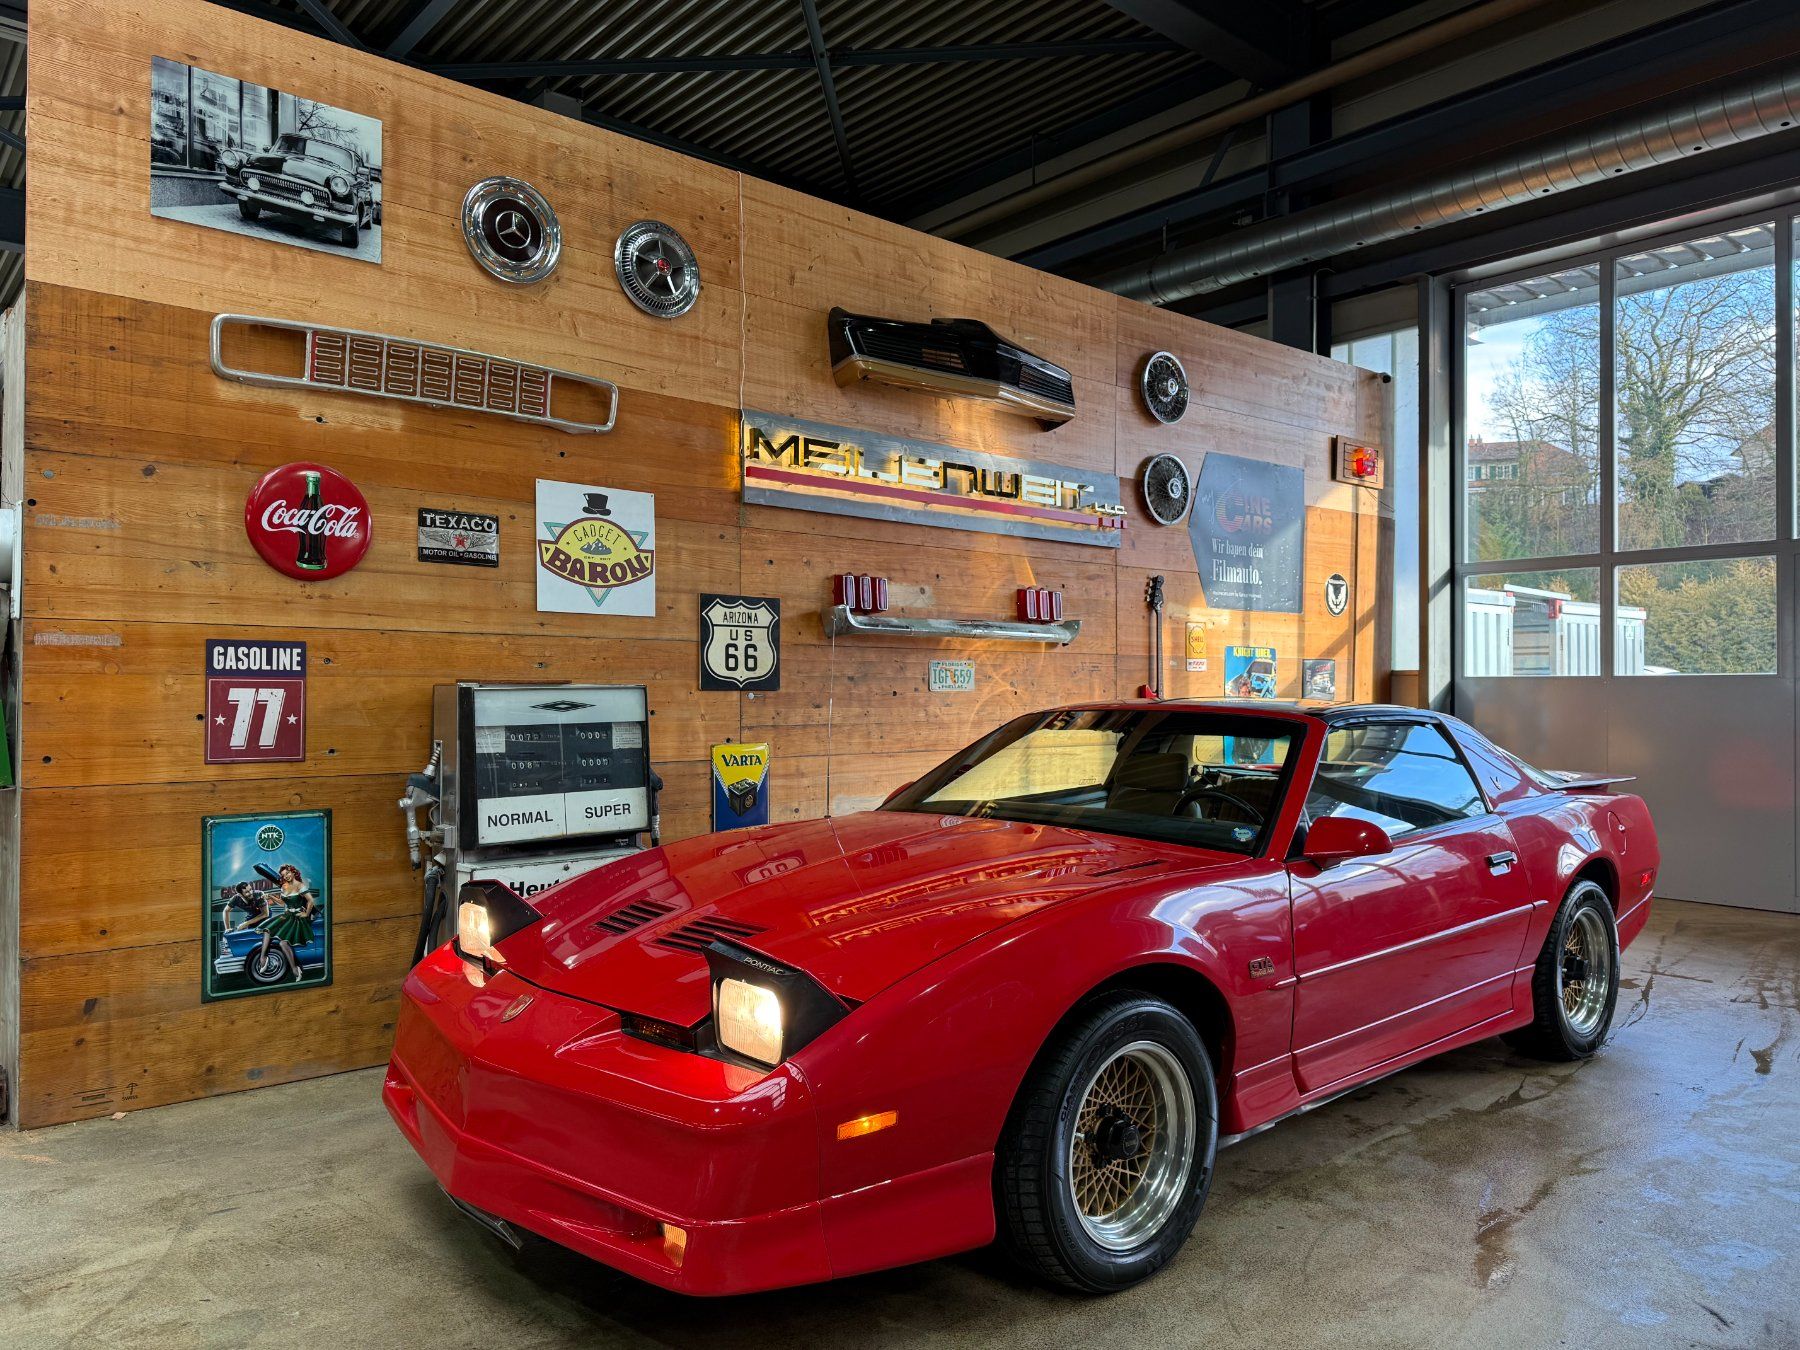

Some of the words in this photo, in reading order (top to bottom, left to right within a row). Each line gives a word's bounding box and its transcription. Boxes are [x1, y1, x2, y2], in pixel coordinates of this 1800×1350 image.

[261, 499, 361, 538] Coca-Cola
[422, 511, 497, 532] TEXACO
[573, 524, 622, 545] GADGET
[422, 548, 448, 556] MOTOR
[463, 552, 497, 561] GASOLINE
[1211, 538, 1224, 554] Wir
[1226, 540, 1247, 557] bauen
[1248, 542, 1264, 559] dein
[546, 545, 650, 584] BARON
[1212, 559, 1263, 585] Filmauto.
[723, 611, 758, 624] ARIZONA
[729, 629, 753, 641] US
[213, 646, 301, 671] GASOLINE
[724, 643, 758, 672] 66
[228, 688, 286, 749] 77
[721, 754, 762, 767] VARTA
[487, 810, 553, 827] NORMAL
[584, 803, 631, 819] SUPER
[743, 956, 784, 975] PONTIAC
